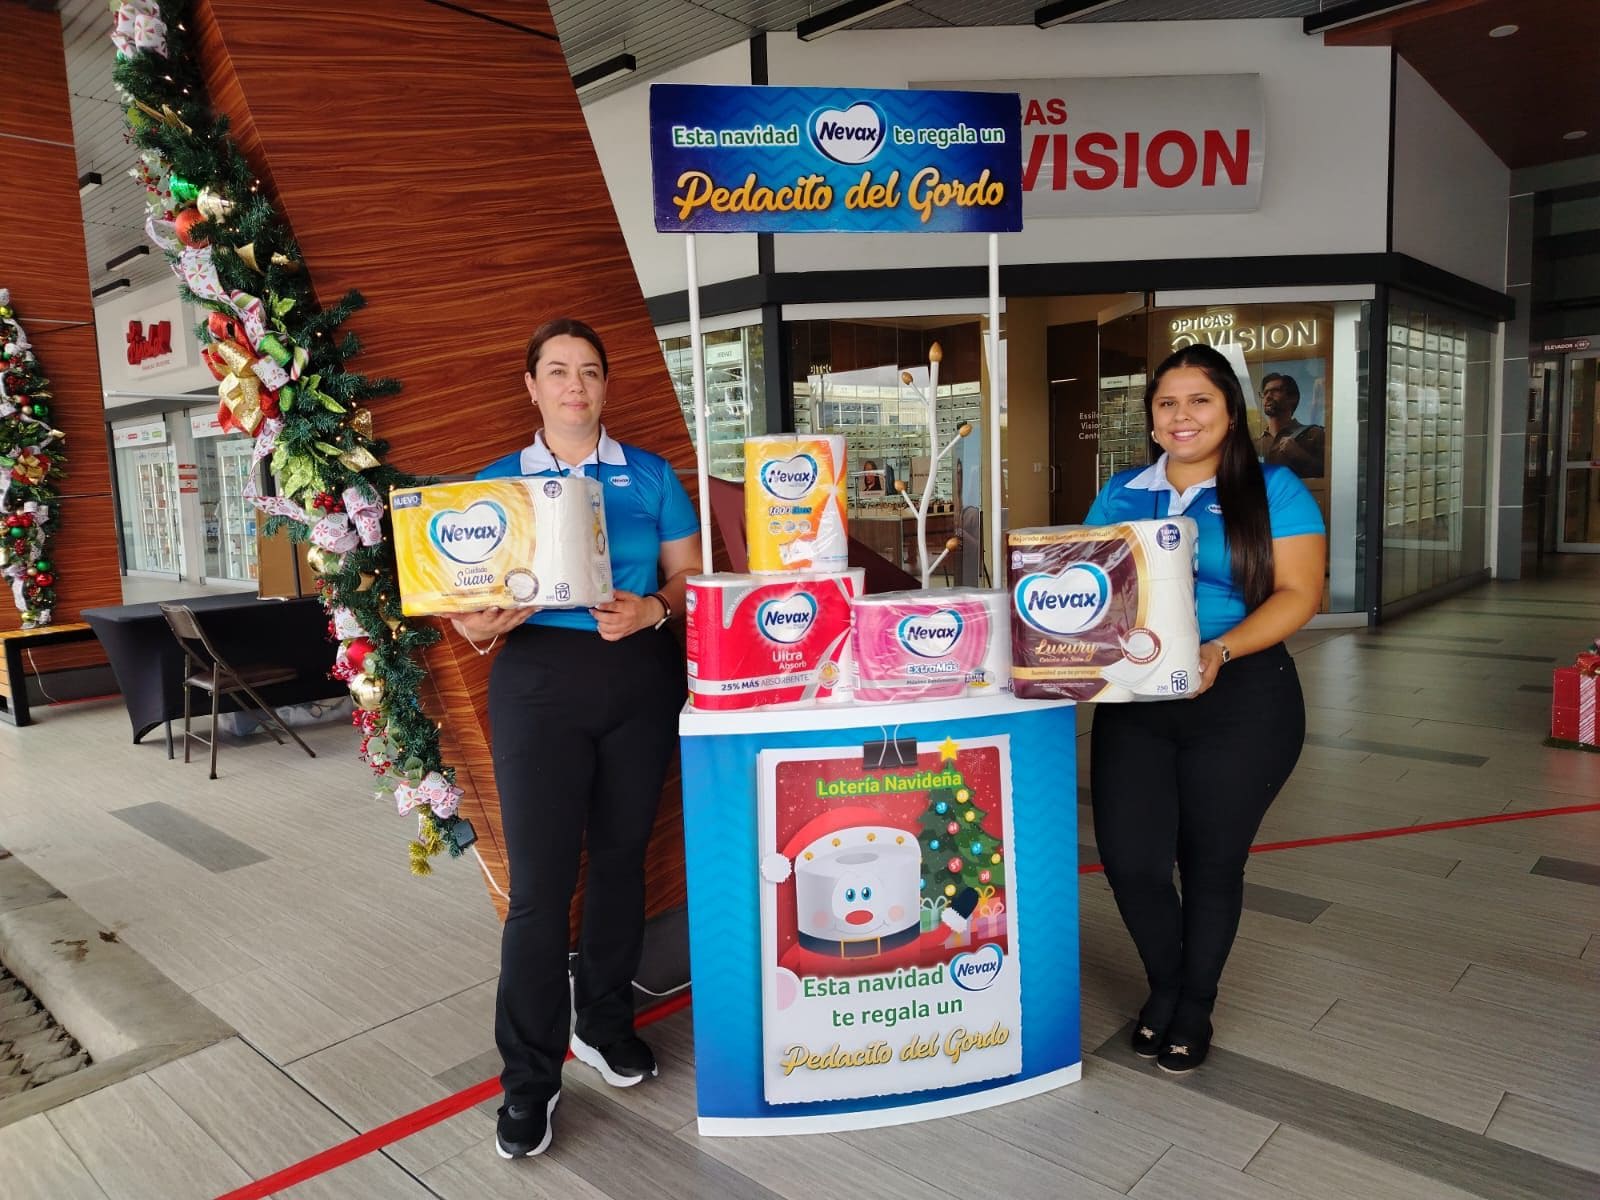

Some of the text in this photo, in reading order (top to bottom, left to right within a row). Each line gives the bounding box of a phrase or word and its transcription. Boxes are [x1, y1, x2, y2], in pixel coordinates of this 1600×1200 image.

[672, 125, 799, 146] Esta navidad
[819, 121, 877, 142] Nevax
[894, 126, 1005, 147] te regala un
[673, 167, 1004, 223] Pedacito del Gordo
[1171, 313, 1234, 333] OPTICAS
[768, 470, 810, 483] Nevax
[393, 495, 418, 506] NUEVO
[441, 524, 498, 543] Nevax
[454, 571, 495, 587] Suave
[557, 590, 568, 599] 12
[1028, 590, 1097, 610] Nevax
[765, 611, 810, 626] Nevax
[907, 626, 955, 641] Nevax
[772, 650, 803, 662] Ultra
[1035, 639, 1098, 662] Luxury
[779, 661, 807, 670] Absorb
[906, 660, 960, 675] ExtraMás
[721, 674, 809, 691] 25% MÁS ABSORBENTE
[1172, 679, 1187, 691] 18
[817, 771, 962, 796] Lotería Navideña
[957, 957, 998, 977] Nevax
[803, 965, 944, 998] Esta navidad
[832, 998, 963, 1027] te regala un
[781, 1021, 1010, 1076] Pedacito del Gordo
